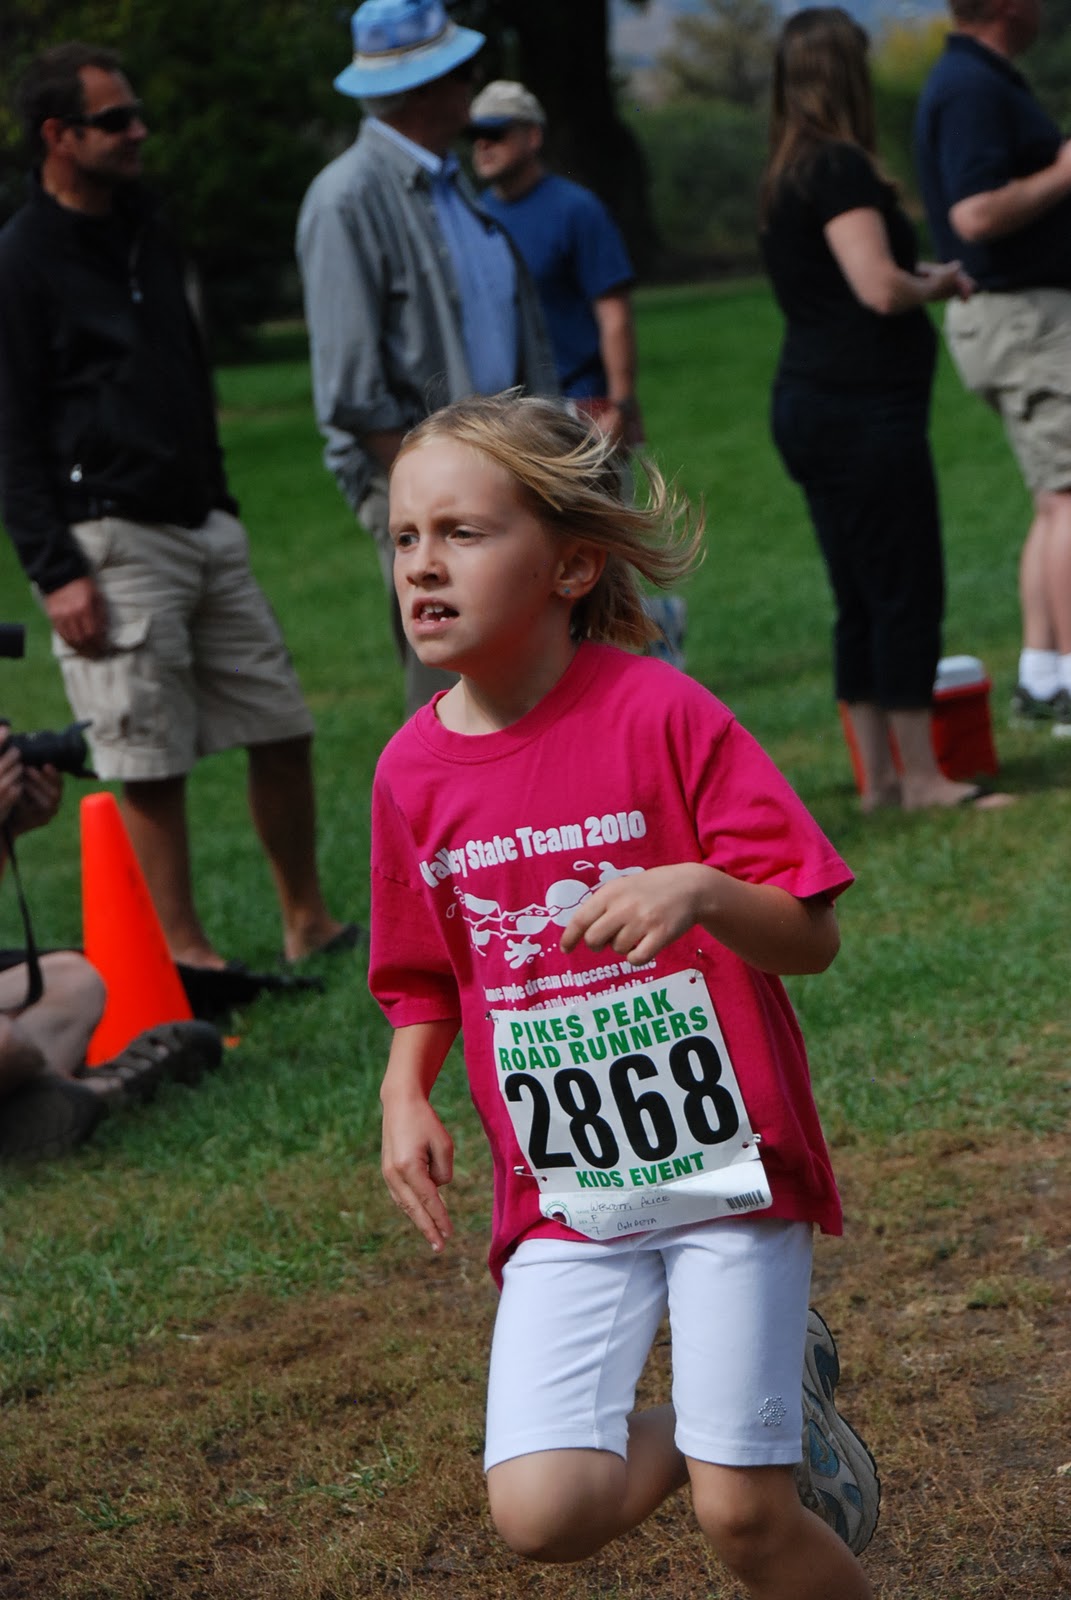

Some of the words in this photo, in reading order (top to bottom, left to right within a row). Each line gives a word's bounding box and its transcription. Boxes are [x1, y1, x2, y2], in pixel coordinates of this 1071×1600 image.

[465, 835, 518, 871] State
[515, 826, 583, 858] Team
[584, 810, 647, 847] 2010
[525, 974, 562, 996] dream
[561, 969, 574, 987] of
[573, 963, 620, 987] uccess
[498, 1044, 561, 1071] ROAD
[568, 1006, 708, 1065] RUNNERS
[510, 1014, 585, 1045] PIKES
[592, 988, 675, 1032] PEAK
[504, 1035, 739, 1170] 2868
[576, 1169, 624, 1188] KIDS
[629, 1151, 705, 1186] EVENT
